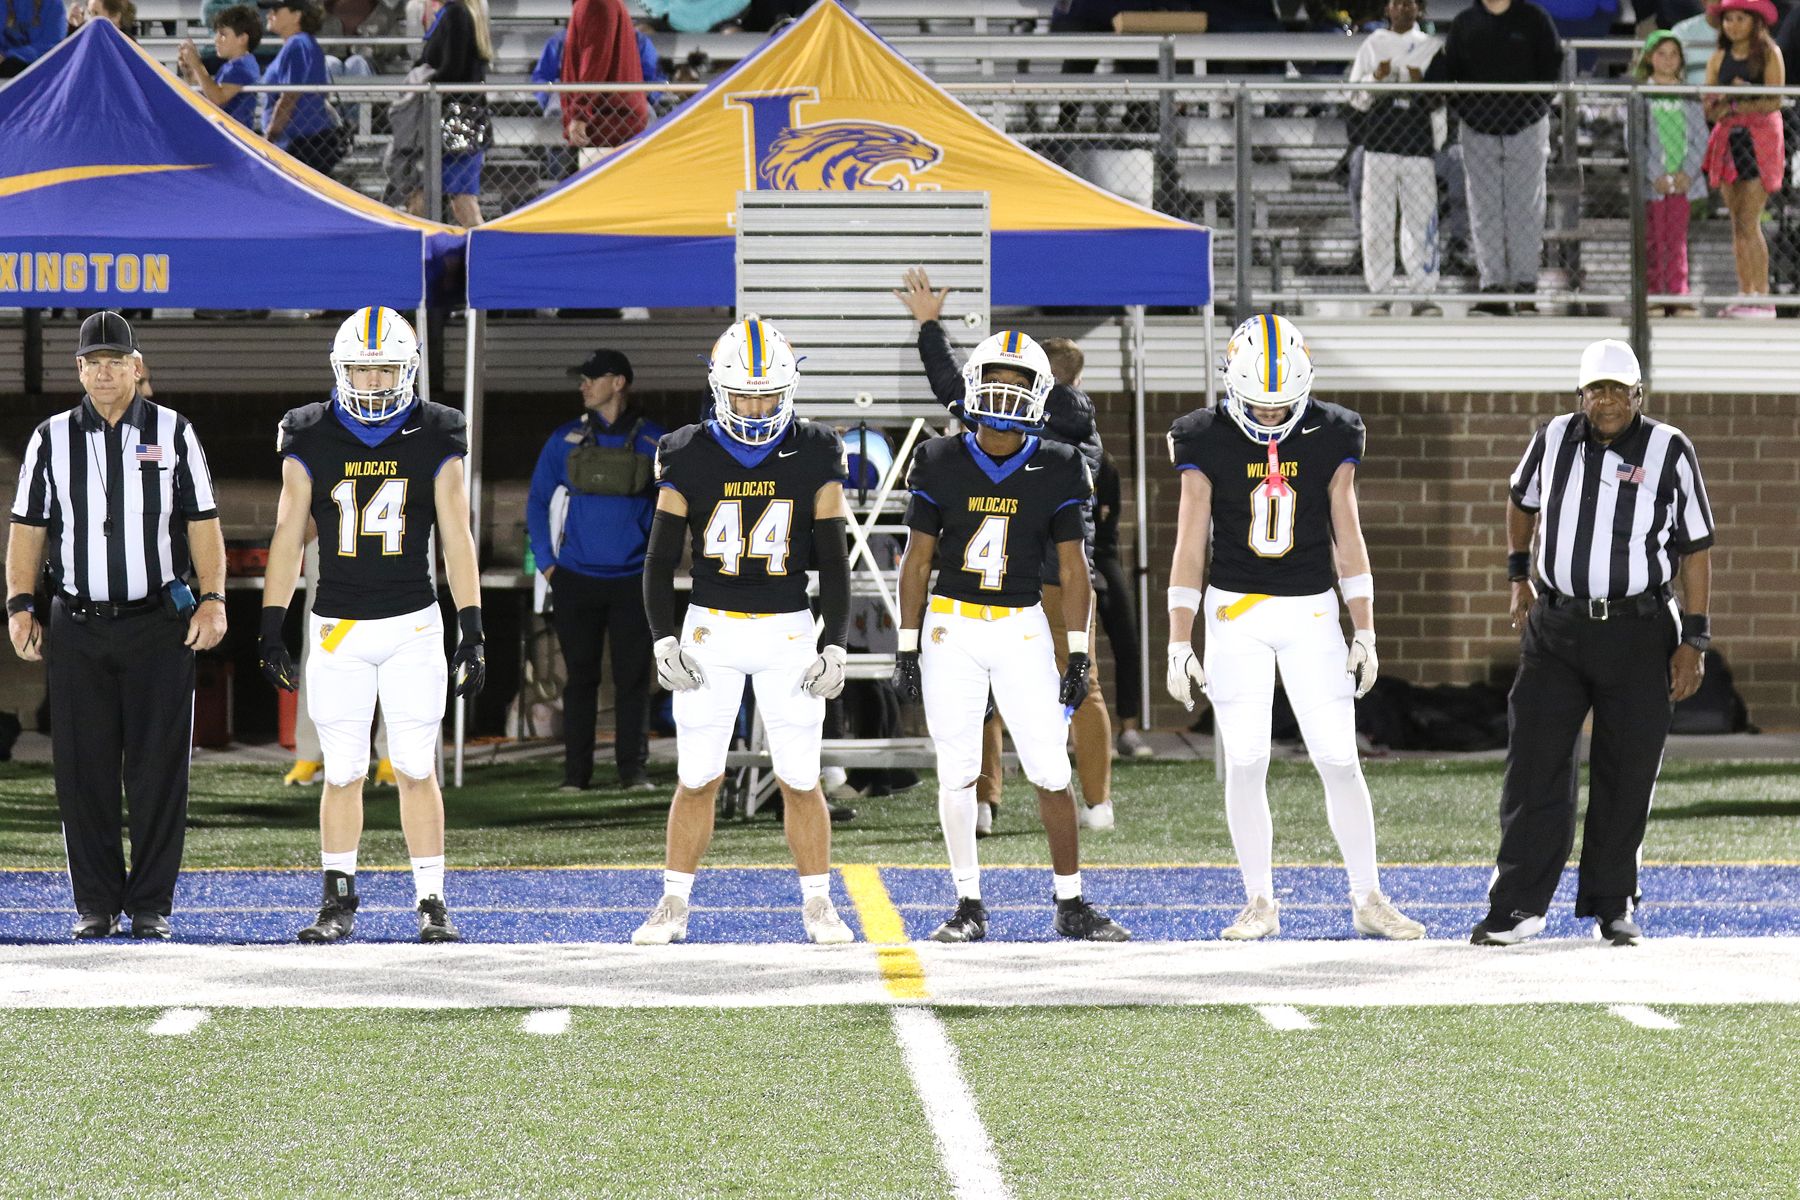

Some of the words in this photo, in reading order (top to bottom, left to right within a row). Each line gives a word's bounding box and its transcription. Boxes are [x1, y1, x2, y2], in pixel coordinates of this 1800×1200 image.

[0, 252, 170, 293] XINGTON
[344, 461, 398, 476] WILDCATS
[724, 481, 776, 497] WILDCATS
[1247, 461, 1298, 478] WILATS
[331, 478, 408, 557] 14
[968, 496, 1018, 514] WILDCATS
[1247, 478, 1297, 558] 0
[703, 499, 794, 576] 44
[961, 514, 1010, 590] 4
